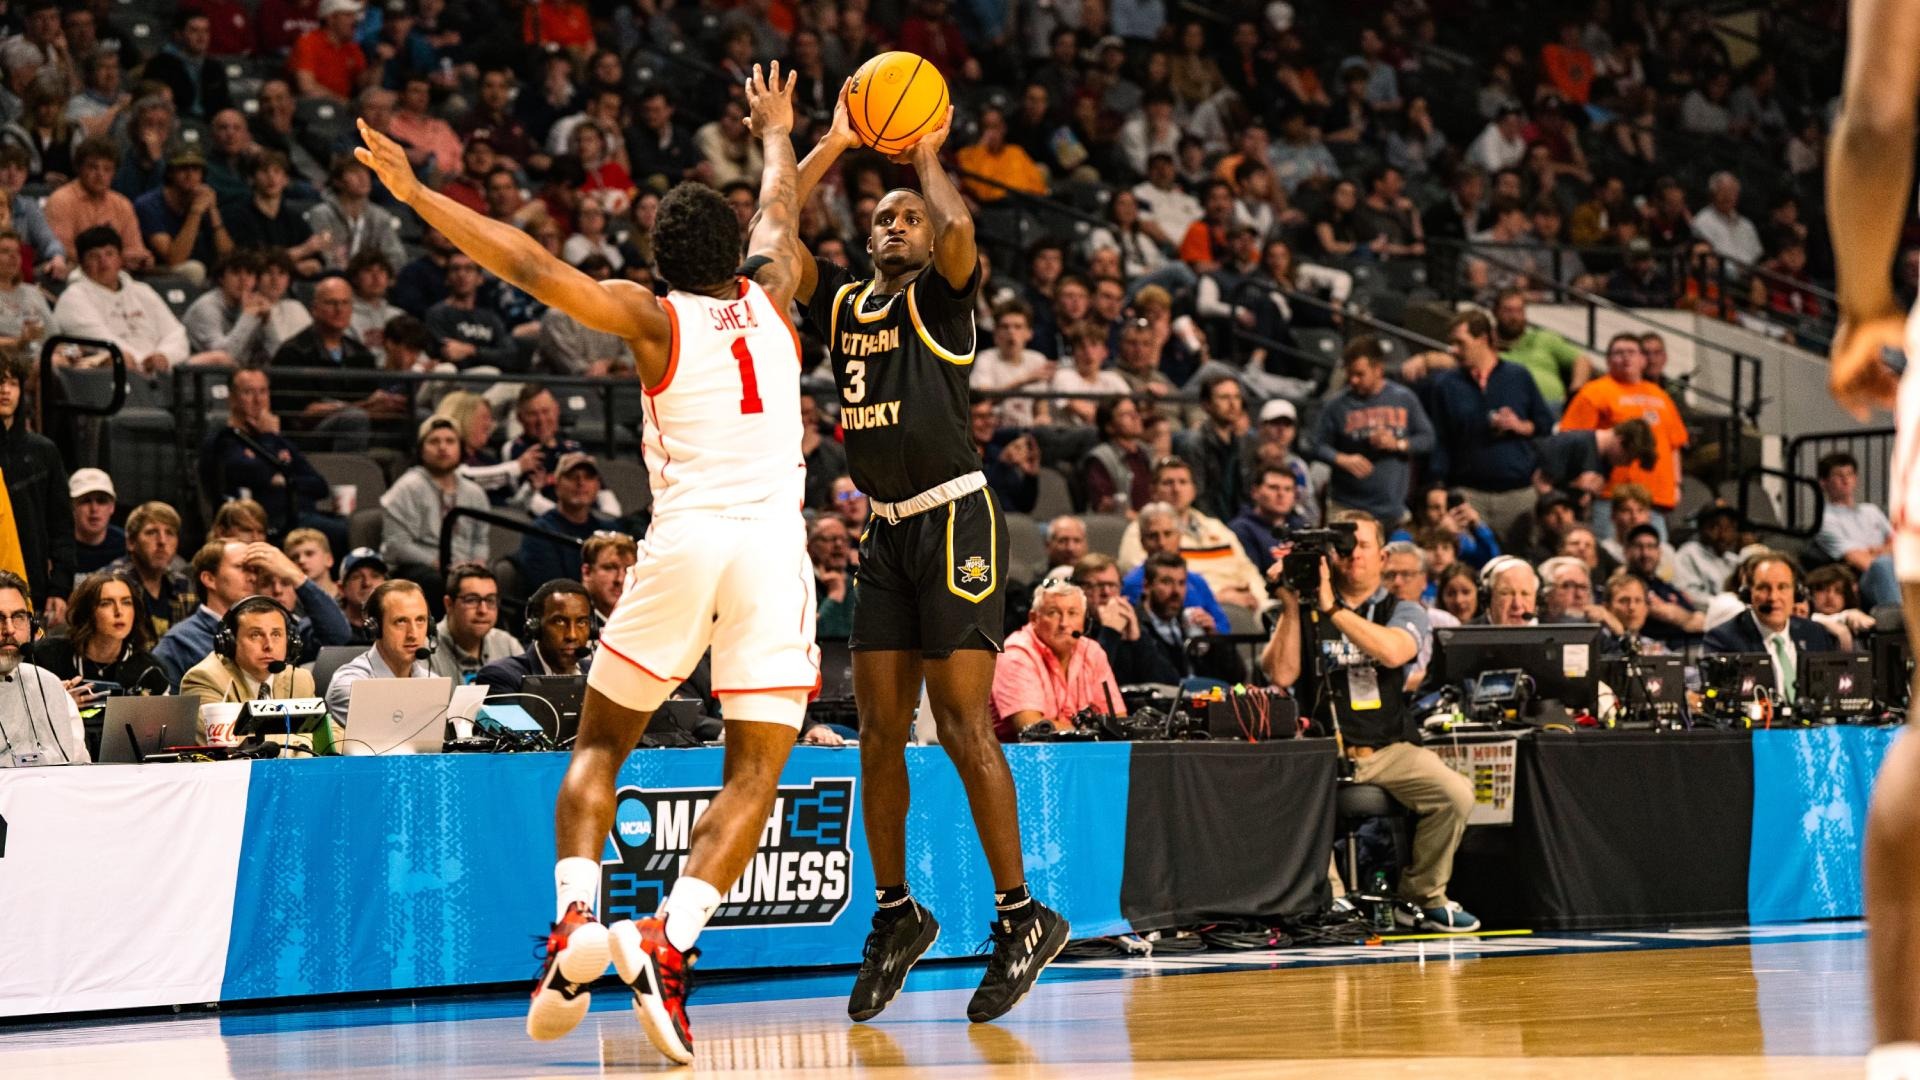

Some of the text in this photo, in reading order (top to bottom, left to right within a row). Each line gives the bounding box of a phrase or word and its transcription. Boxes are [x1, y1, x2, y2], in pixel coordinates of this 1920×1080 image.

[709, 300, 759, 331] SHEA
[731, 336, 764, 414] 1
[843, 360, 866, 403] 3
[840, 400, 901, 430] NTUCKY
[620, 820, 651, 835] NCAA
[678, 850, 846, 904] DNESS
